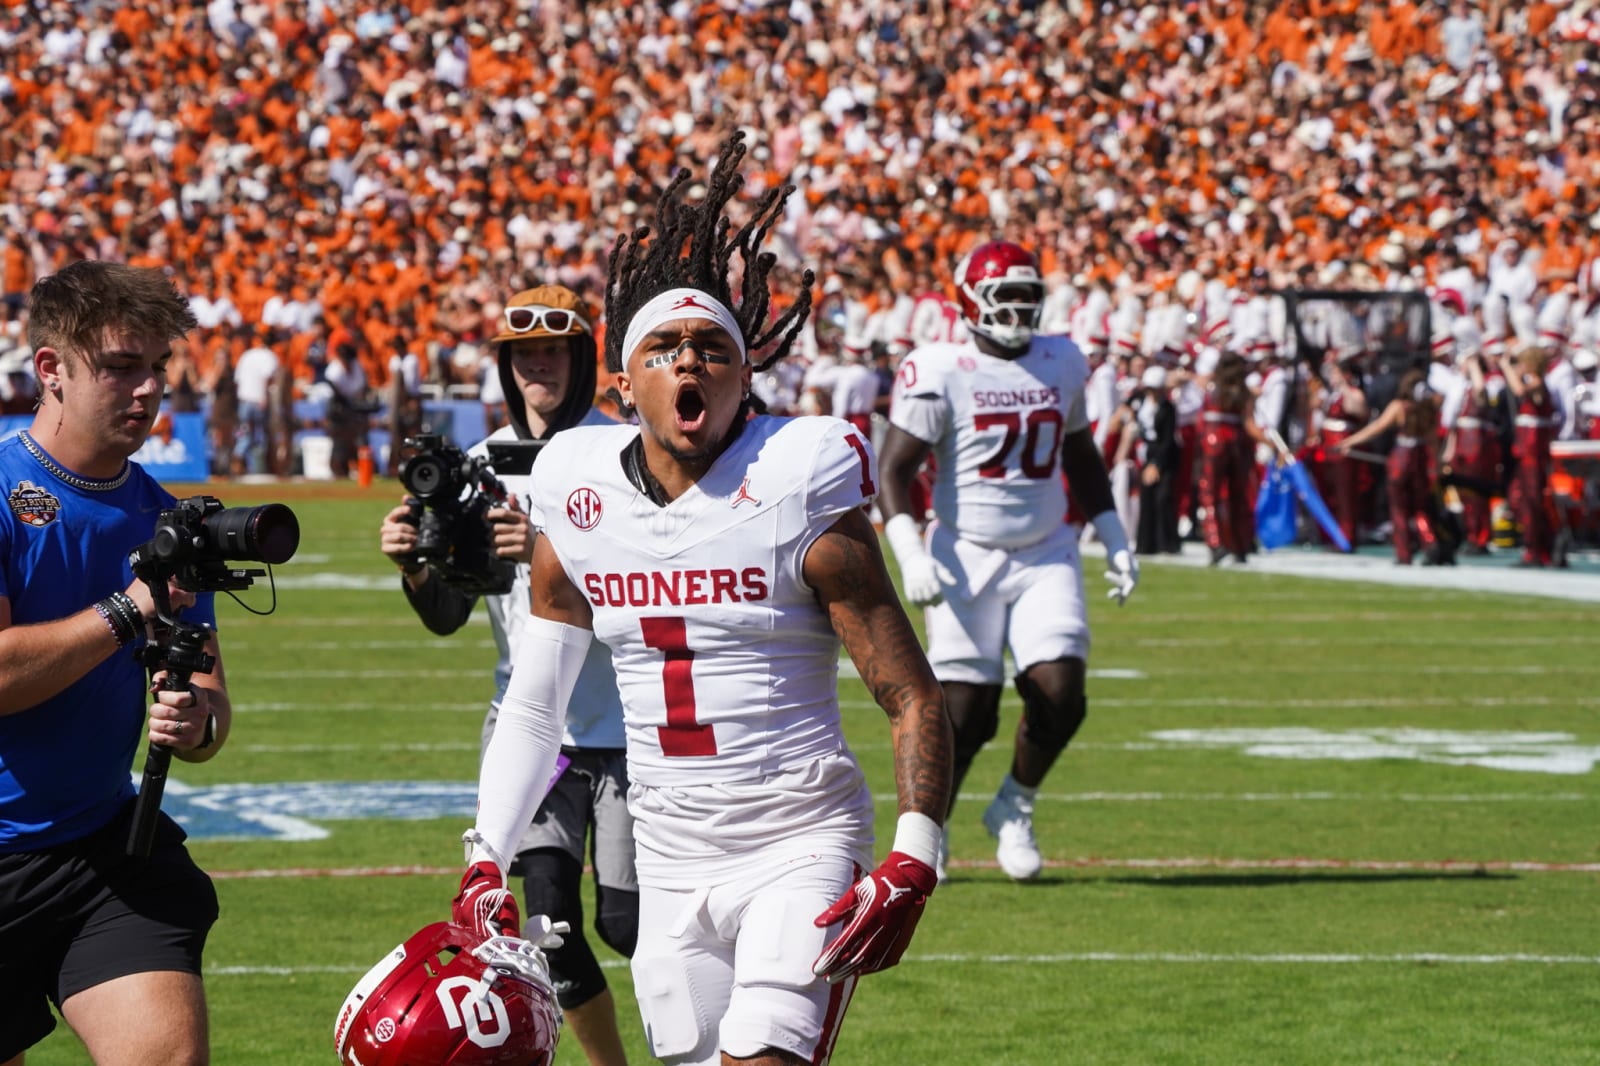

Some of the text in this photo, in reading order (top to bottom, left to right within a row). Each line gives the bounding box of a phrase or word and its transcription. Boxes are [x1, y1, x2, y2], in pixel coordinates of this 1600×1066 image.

[974, 387, 1061, 408] SOONERS
[844, 433, 875, 498] 1
[974, 409, 1063, 479] 70
[569, 489, 602, 527] SEC
[584, 567, 768, 607] SOONERS
[640, 616, 717, 756] 1
